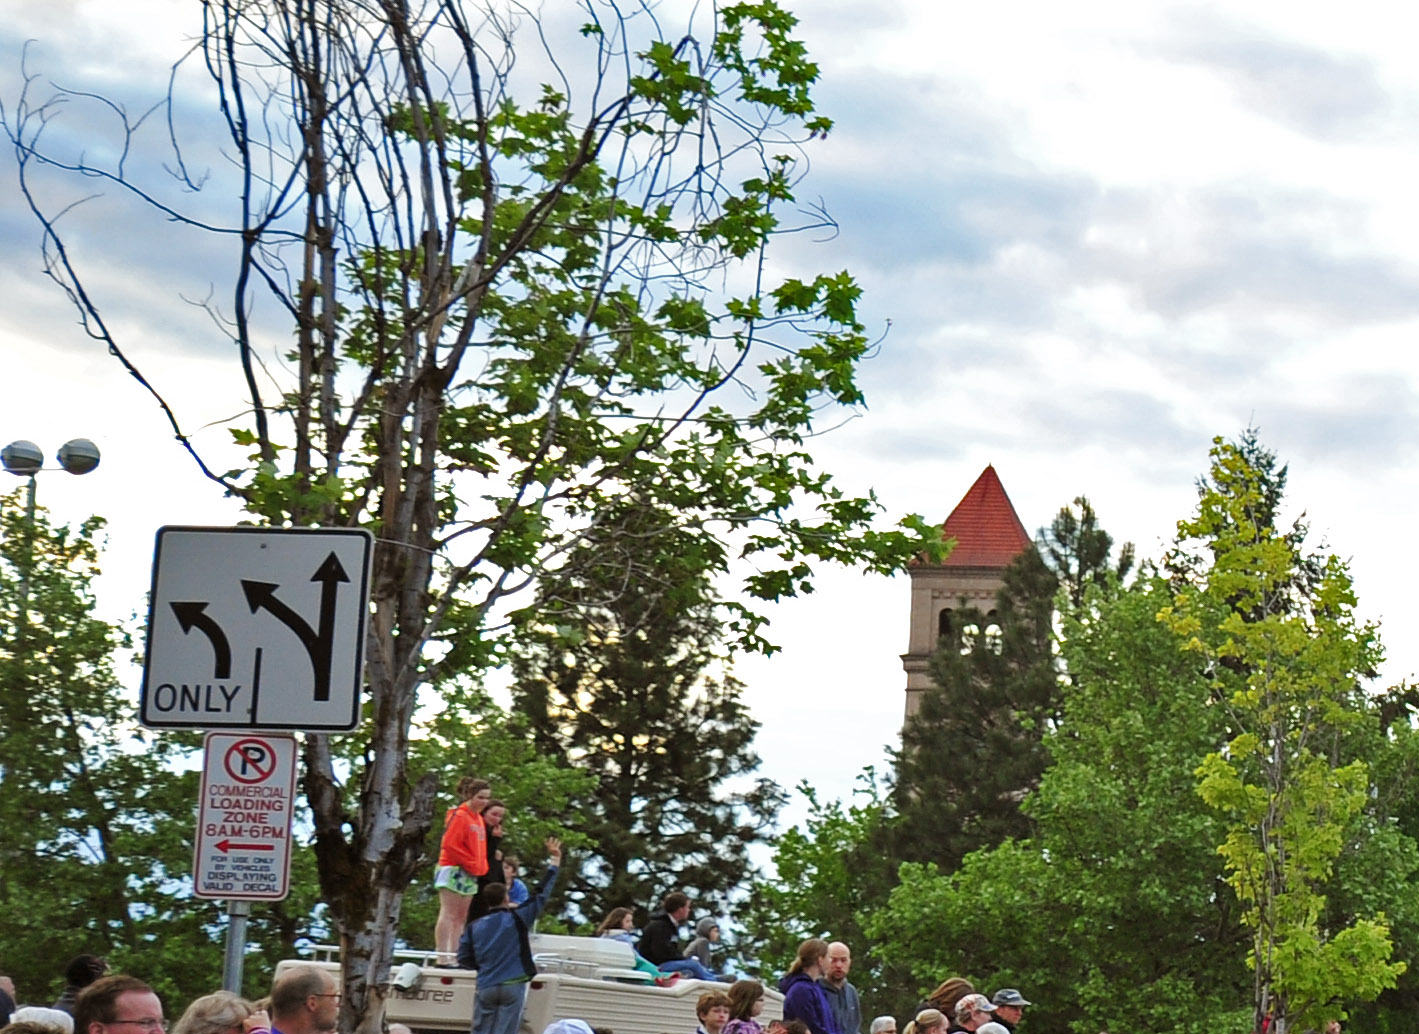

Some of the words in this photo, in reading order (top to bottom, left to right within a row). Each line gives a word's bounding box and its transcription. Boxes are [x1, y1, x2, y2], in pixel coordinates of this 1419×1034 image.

[154, 684, 241, 714] ONLY
[209, 784, 288, 799] COMMERCIAL
[210, 798, 284, 811] LOADING
[223, 811, 269, 825] ZONE
[253, 857, 275, 865] ONLY
[207, 871, 277, 883] DISPLAYING
[203, 882, 234, 891] VALID
[243, 882, 279, 893] DECAL
